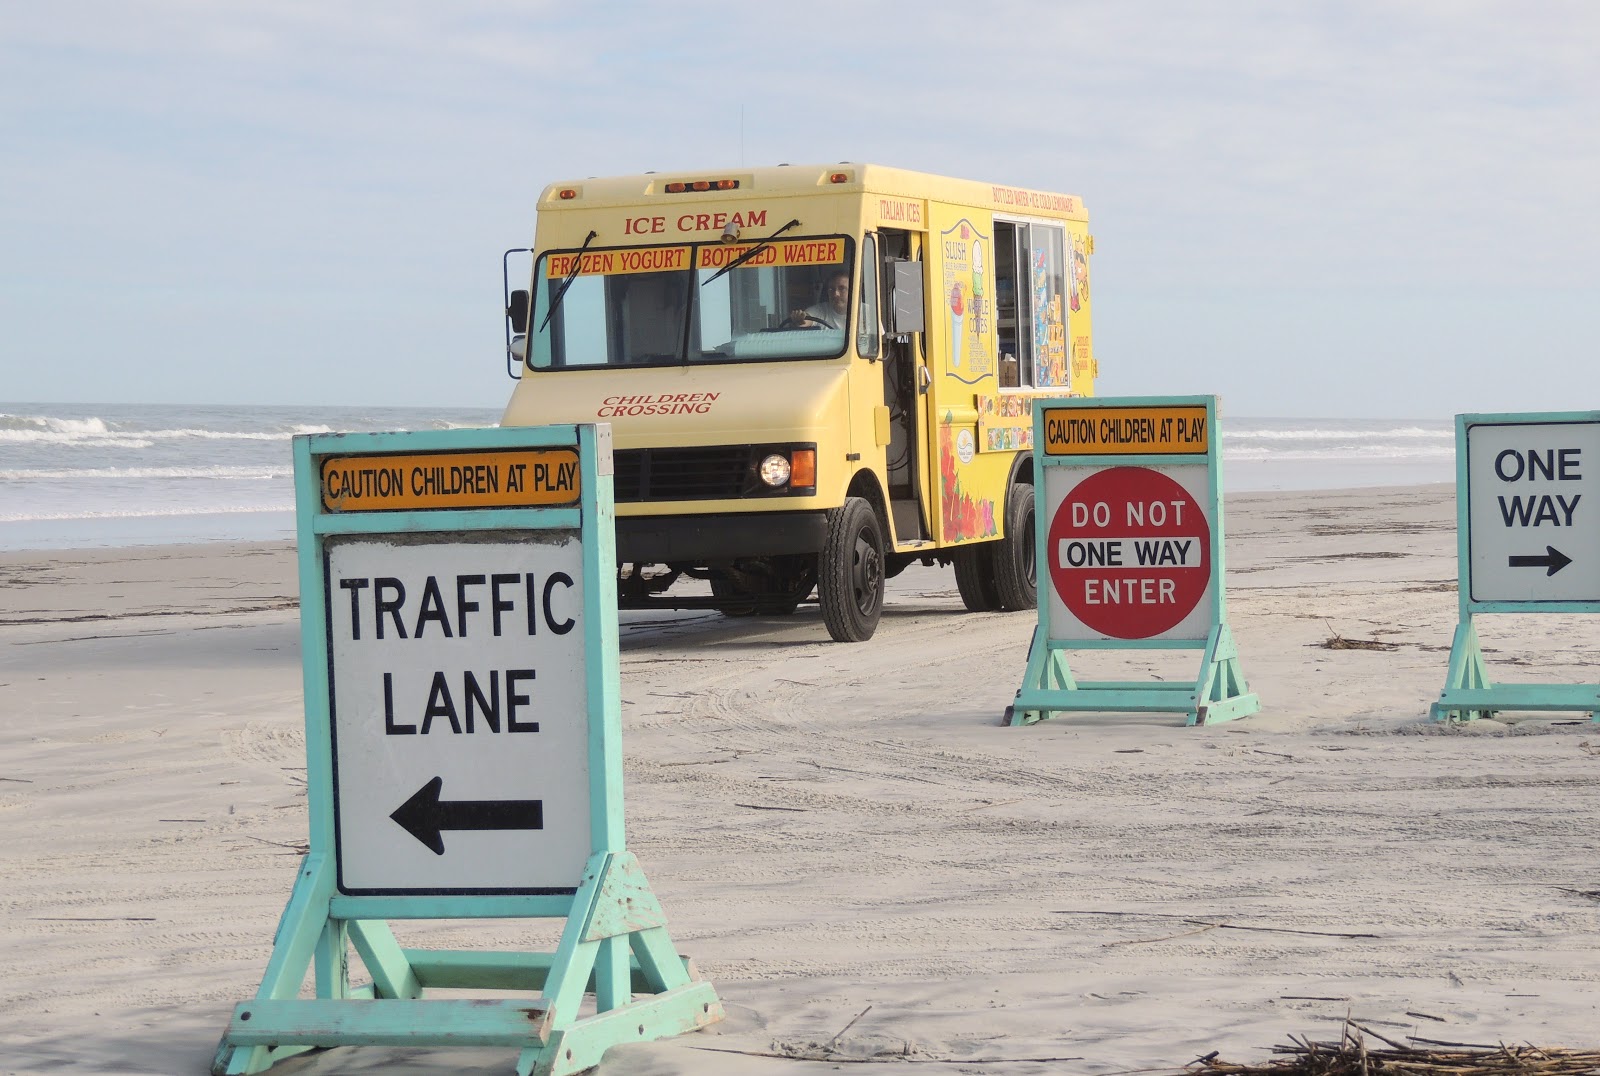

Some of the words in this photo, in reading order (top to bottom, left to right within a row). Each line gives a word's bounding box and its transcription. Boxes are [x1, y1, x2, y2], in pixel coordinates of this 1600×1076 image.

[992, 187, 1014, 205] BOTTLED
[624, 217, 666, 235] ICE
[677, 210, 768, 232] CREAM
[880, 200, 904, 221] ITALIAN
[906, 202, 920, 223] ICES
[550, 254, 614, 276] FROZEN
[620, 249, 685, 271] YOGURT
[701, 245, 777, 267] BOTTLED
[784, 242, 838, 263] WATER
[945, 241, 967, 261] SLUSH
[597, 402, 712, 418] CROSSING
[603, 392, 721, 406] CHILDREN
[1048, 419, 1096, 444] CAUTION
[1100, 418, 1155, 444] CHILDREN
[1159, 418, 1173, 443] AT
[1177, 417, 1205, 443] PLAY
[1494, 448, 1583, 482] ONE
[327, 468, 403, 499] CAUTION
[411, 466, 499, 496] CHILDREN
[506, 464, 526, 492] AT
[534, 462, 578, 491] PLAY
[1072, 501, 1110, 528] DO
[1127, 501, 1186, 527] NOT
[1497, 494, 1582, 528] WAY
[1066, 541, 1123, 567] ONE
[1134, 540, 1192, 566] WAY
[1084, 578, 1176, 605] ENTER
[339, 571, 576, 641] TRAFFIC
[383, 669, 540, 736] LANE
